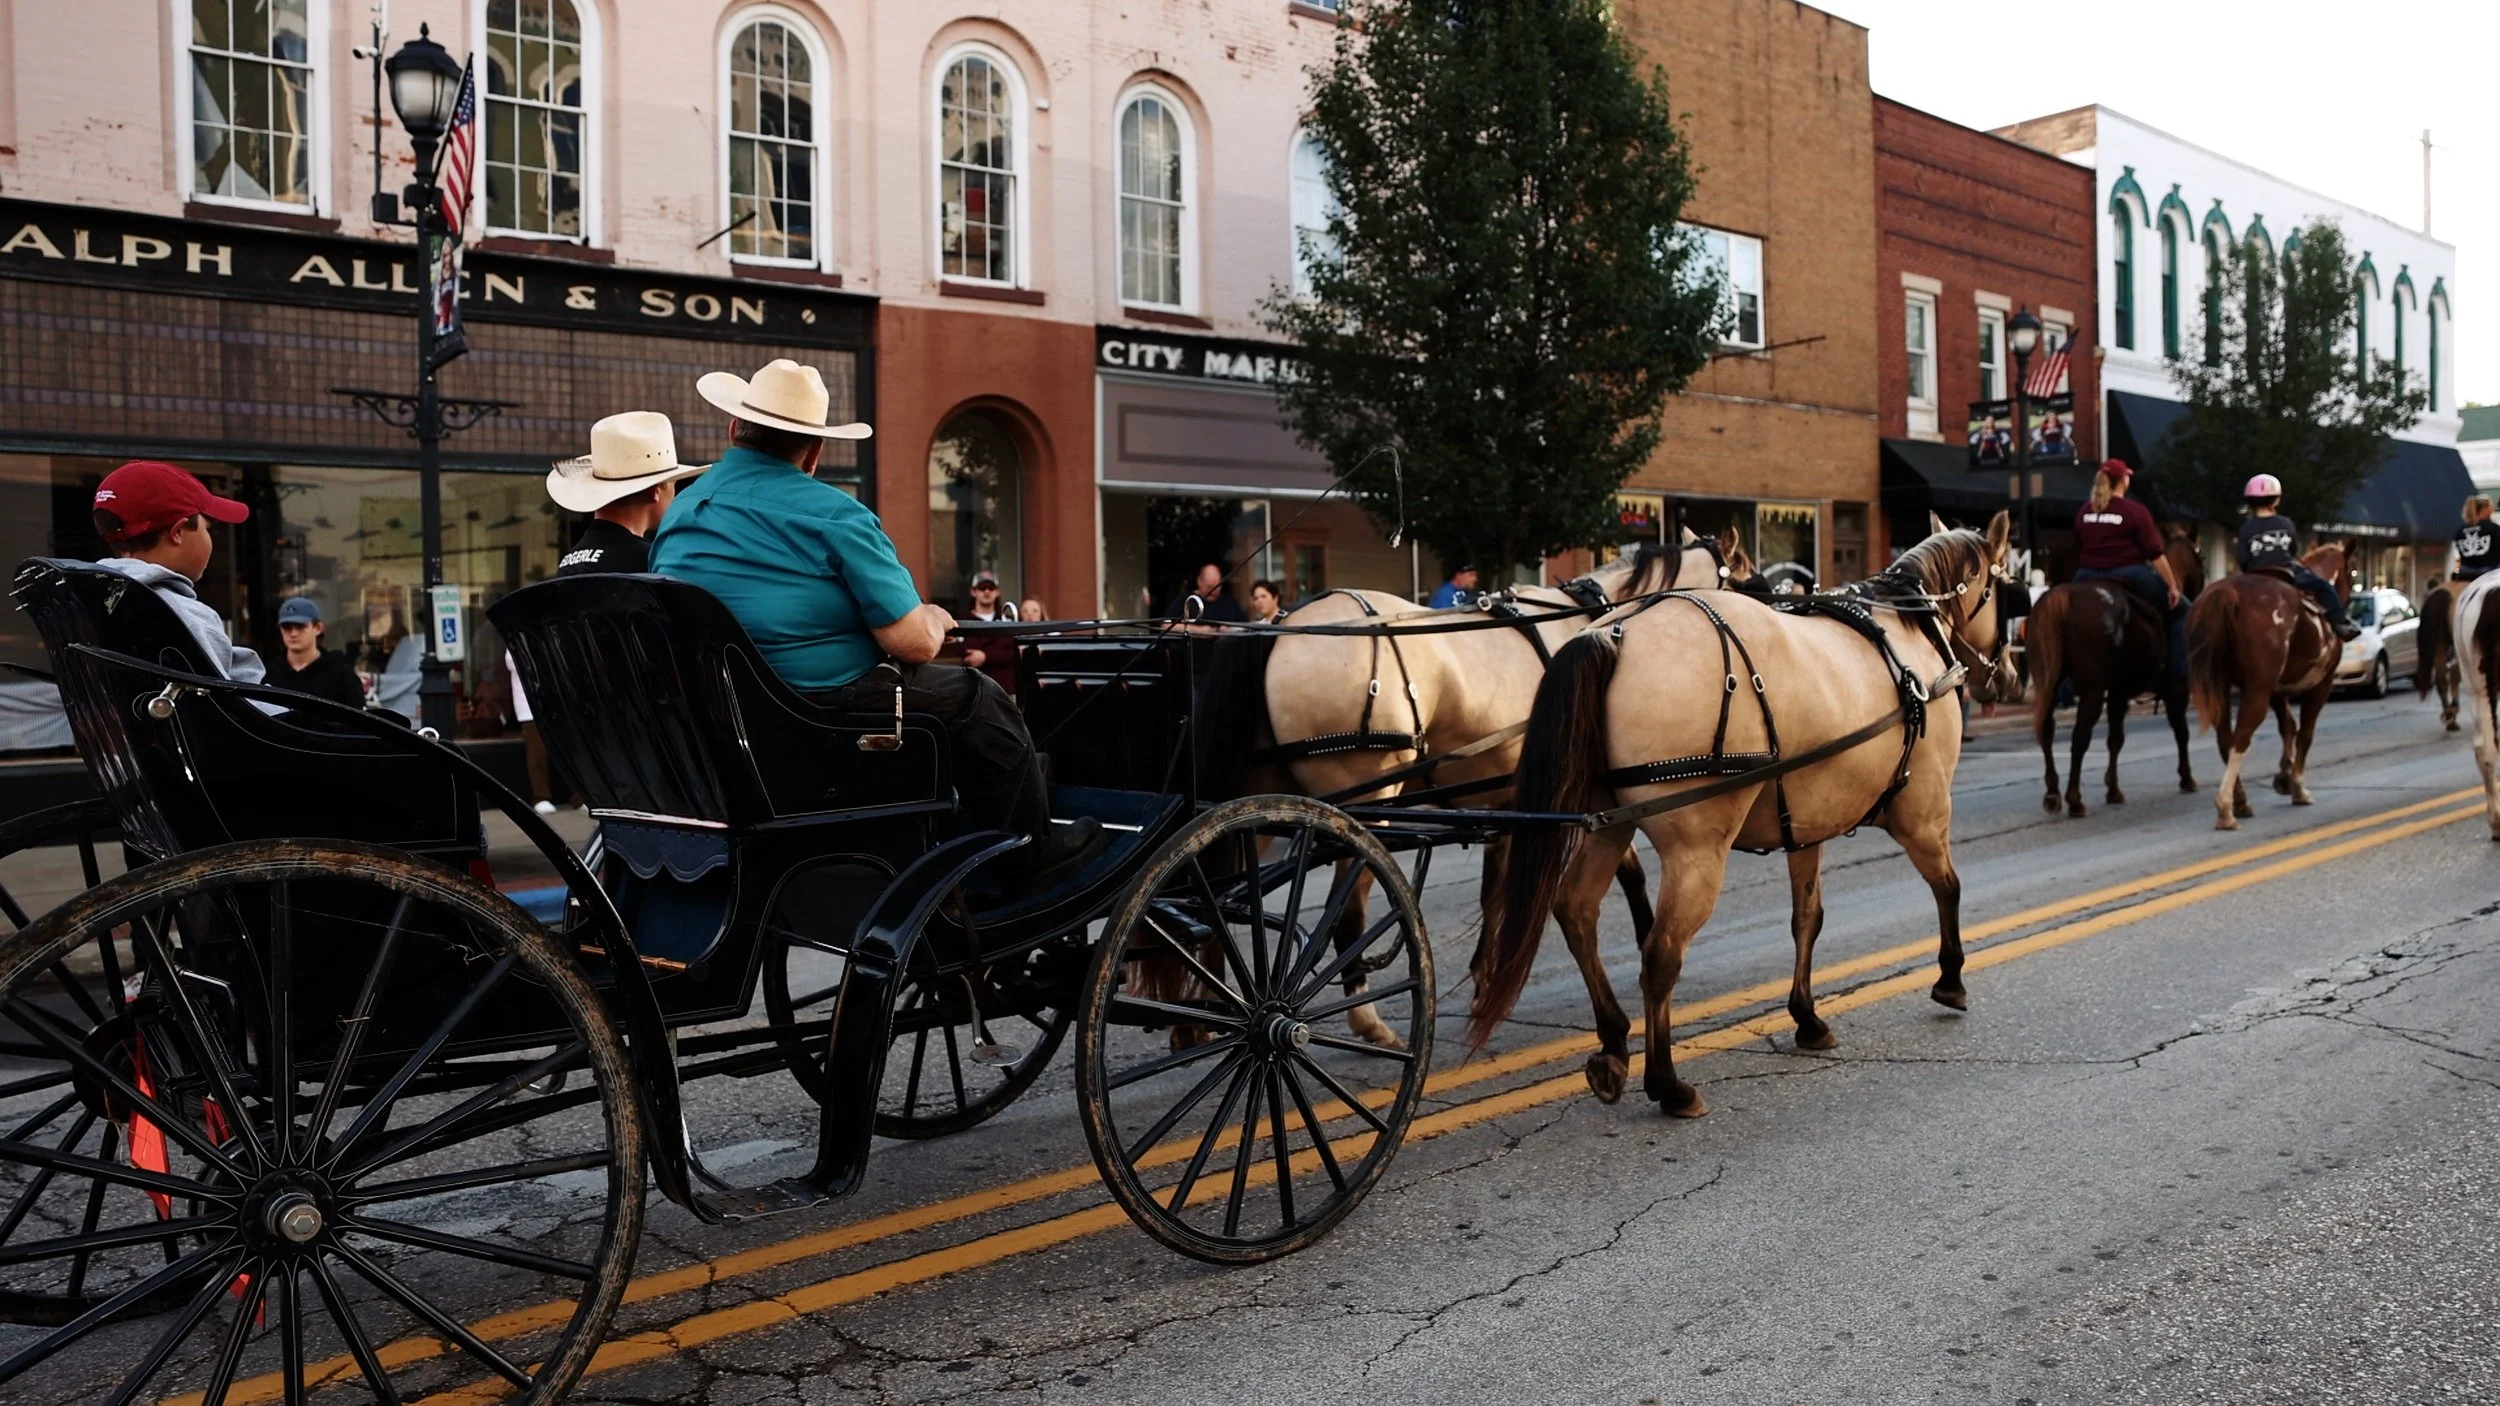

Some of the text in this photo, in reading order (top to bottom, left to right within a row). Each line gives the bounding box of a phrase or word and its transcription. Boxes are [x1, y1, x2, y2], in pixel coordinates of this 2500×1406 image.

[0, 223, 232, 276] ALPH
[565, 285, 597, 310] &
[639, 288, 767, 326] SON
[1102, 340, 1334, 385] CITY MARK
